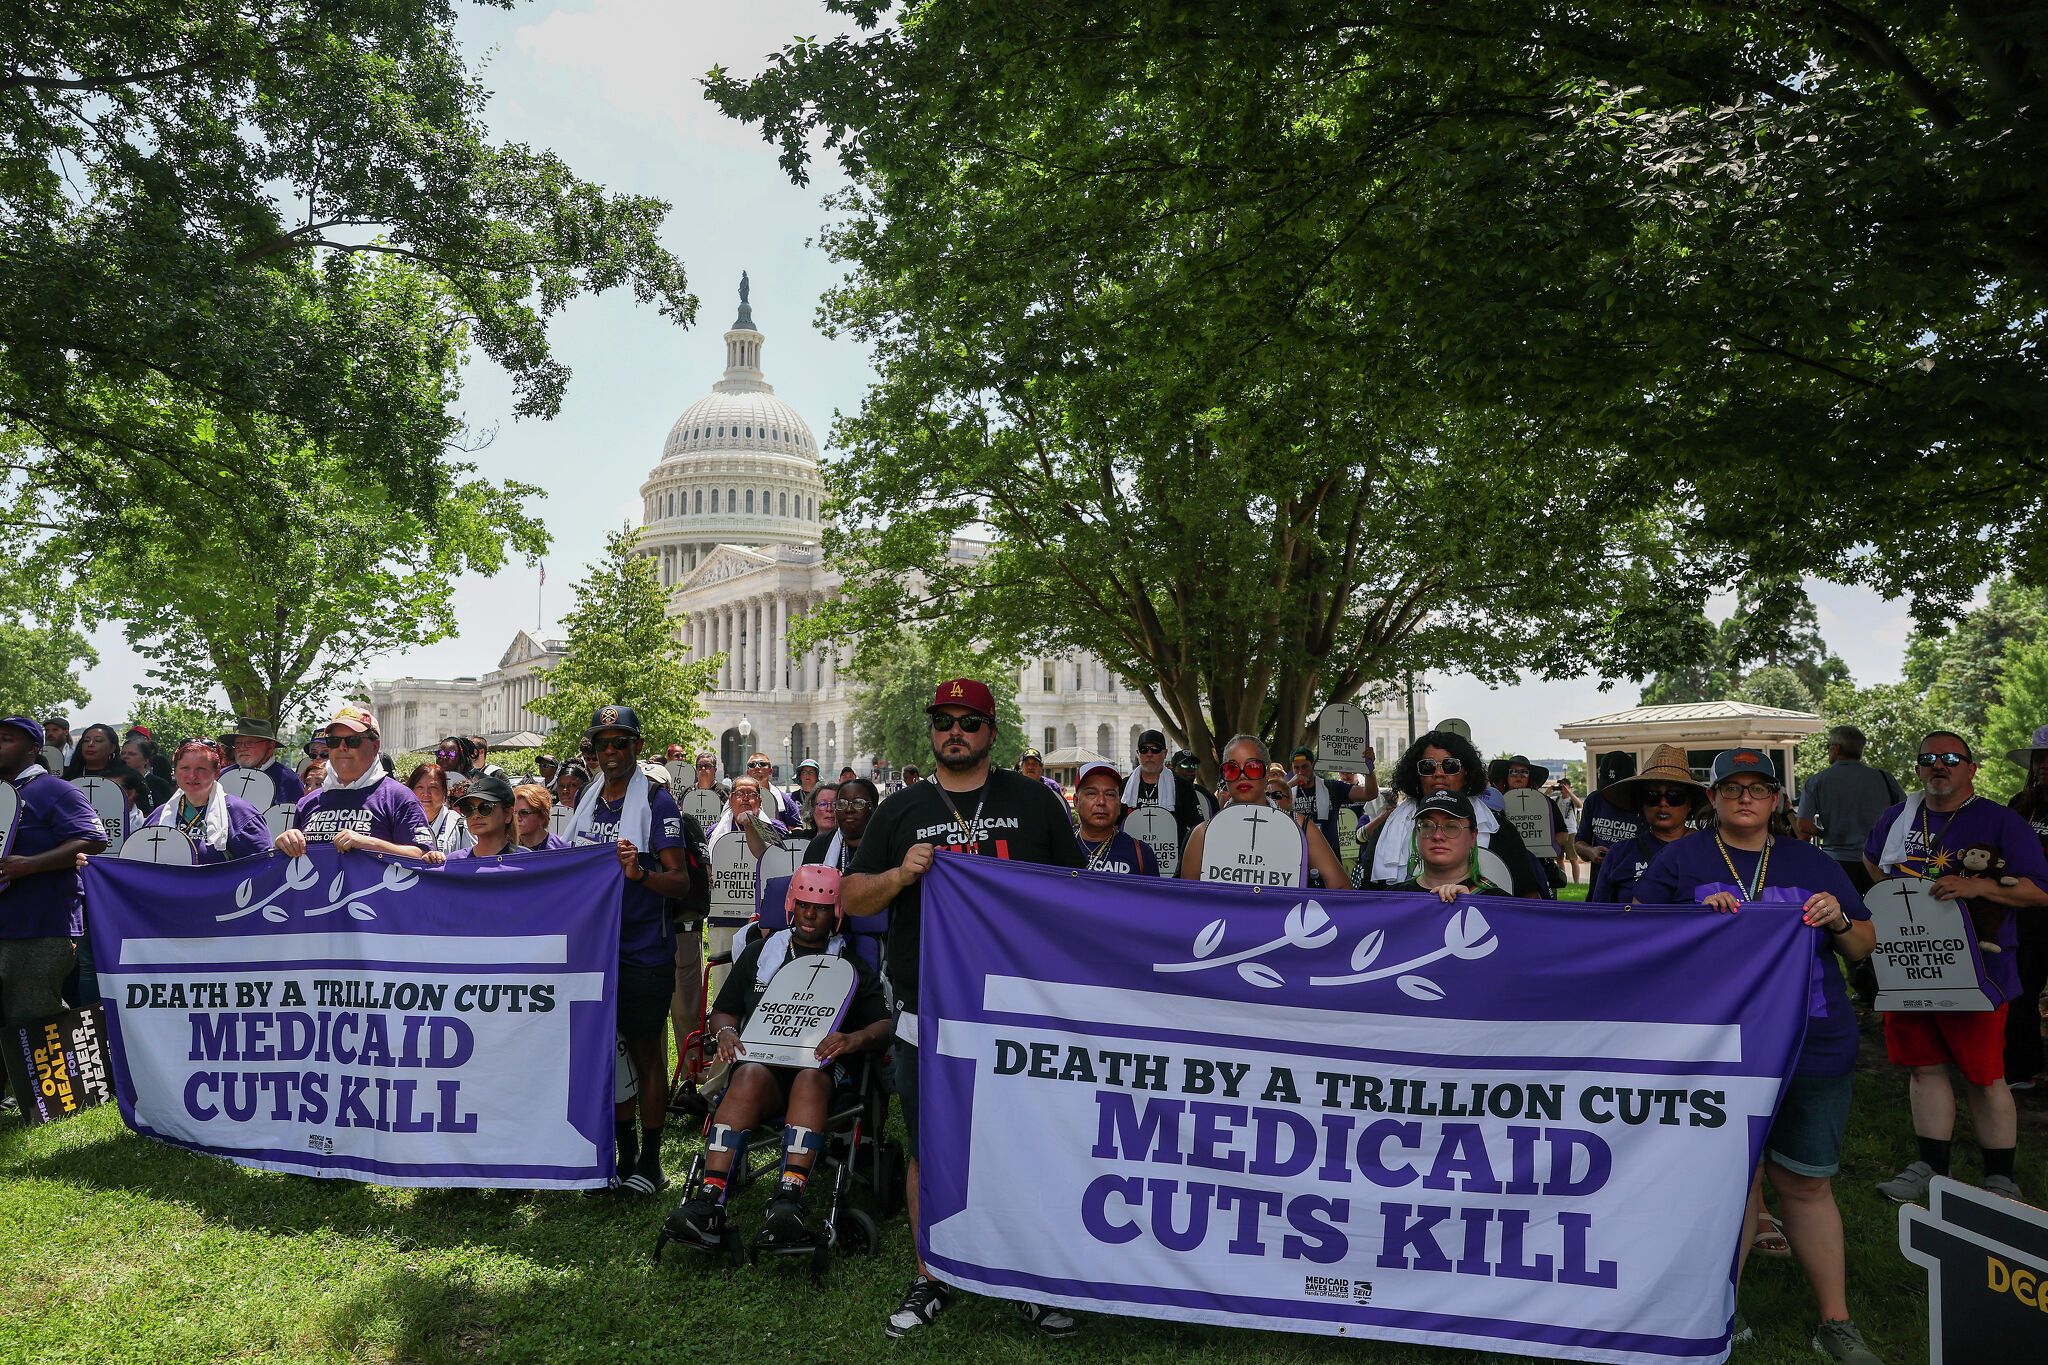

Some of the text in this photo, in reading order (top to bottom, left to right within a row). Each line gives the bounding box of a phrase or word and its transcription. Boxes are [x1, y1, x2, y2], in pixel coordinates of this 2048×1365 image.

[950, 682, 963, 696] LA
[1321, 734, 1364, 744] SACRIFICED
[310, 809, 374, 822] MEDICAID
[304, 822, 372, 832] SAVES LIVES
[1516, 822, 1535, 830] FOR
[1592, 818, 1638, 832] MEDICAID
[1593, 826, 1636, 838] AVES LIVES
[946, 830, 989, 844] CUTS
[1521, 830, 1543, 838] OFIT
[1906, 830, 1936, 844] EIU
[1154, 843, 1175, 851] LIES
[1094, 860, 1130, 874] CAID
[1238, 854, 1266, 866] R.I.P.
[716, 871, 750, 880] DEATH
[1209, 866, 1292, 886] DEATH BY
[723, 881, 756, 889] TRILLI
[728, 890, 754, 899] CUTS
[1900, 925, 1929, 936] R.I.P.
[1875, 939, 1964, 954] SACRIFICED
[1888, 953, 1956, 967] FOR THE
[1906, 967, 1943, 979] RICH
[126, 980, 555, 1013] DEATH BY A TRILLION CUTS
[792, 992, 814, 1001] R.I.P.
[760, 1002, 835, 1017] SACRIFICED
[763, 1014, 821, 1027] FOR THE
[770, 1026, 802, 1037] RICH
[188, 1011, 475, 1068] MEDICAID
[20, 1028, 36, 1077] TRADING
[80, 1010, 110, 1104] WEALTH
[45, 1024, 77, 1112] HEALTH
[66, 1051, 78, 1077] FOR
[72, 1028, 97, 1094] THEIR
[34, 1047, 56, 1096] OUR
[994, 1039, 1727, 1128] DEATH BY A TRILLION CUTS
[184, 1070, 478, 1134] CUTS KILL
[1092, 1090, 1612, 1196] MEDICAID
[1081, 1174, 1618, 1289] CUTS KILL
[1306, 1276, 1348, 1286] MEDICAID
